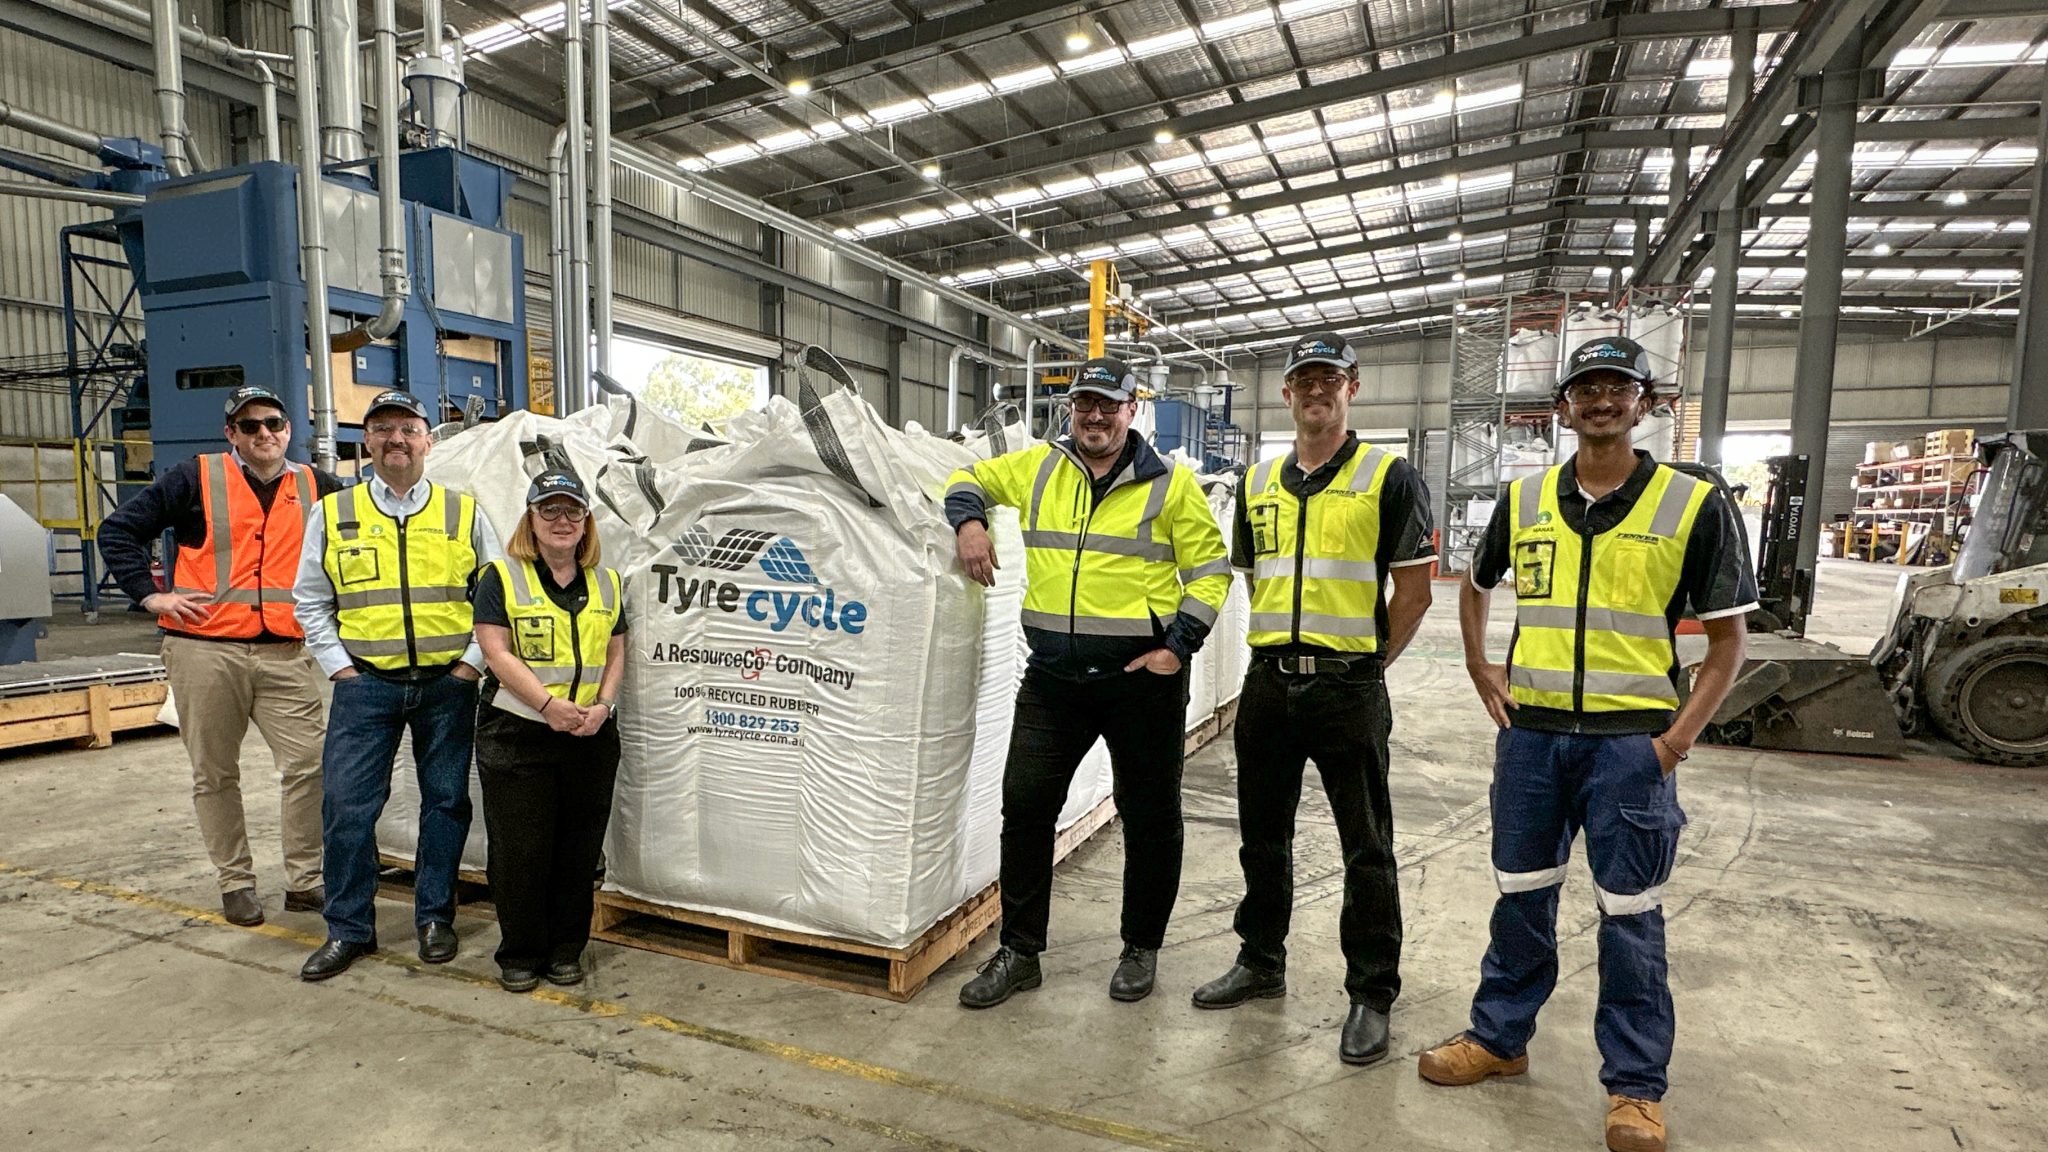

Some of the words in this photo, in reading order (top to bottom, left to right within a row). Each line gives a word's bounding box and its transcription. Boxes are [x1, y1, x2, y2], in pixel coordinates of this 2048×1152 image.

[1787, 505, 1800, 540] TOYOTA
[652, 642, 664, 661] A
[668, 643, 765, 672] ResourceCo
[775, 654, 855, 690] Company
[673, 686, 706, 699] 100%
[707, 687, 766, 707] RECYCLED
[769, 694, 820, 716] RUBBER
[687, 725, 805, 748] www.tyrecycle.com.au
[704, 709, 736, 726] 1300
[739, 713, 766, 730] 829
[770, 718, 800, 734] 253
